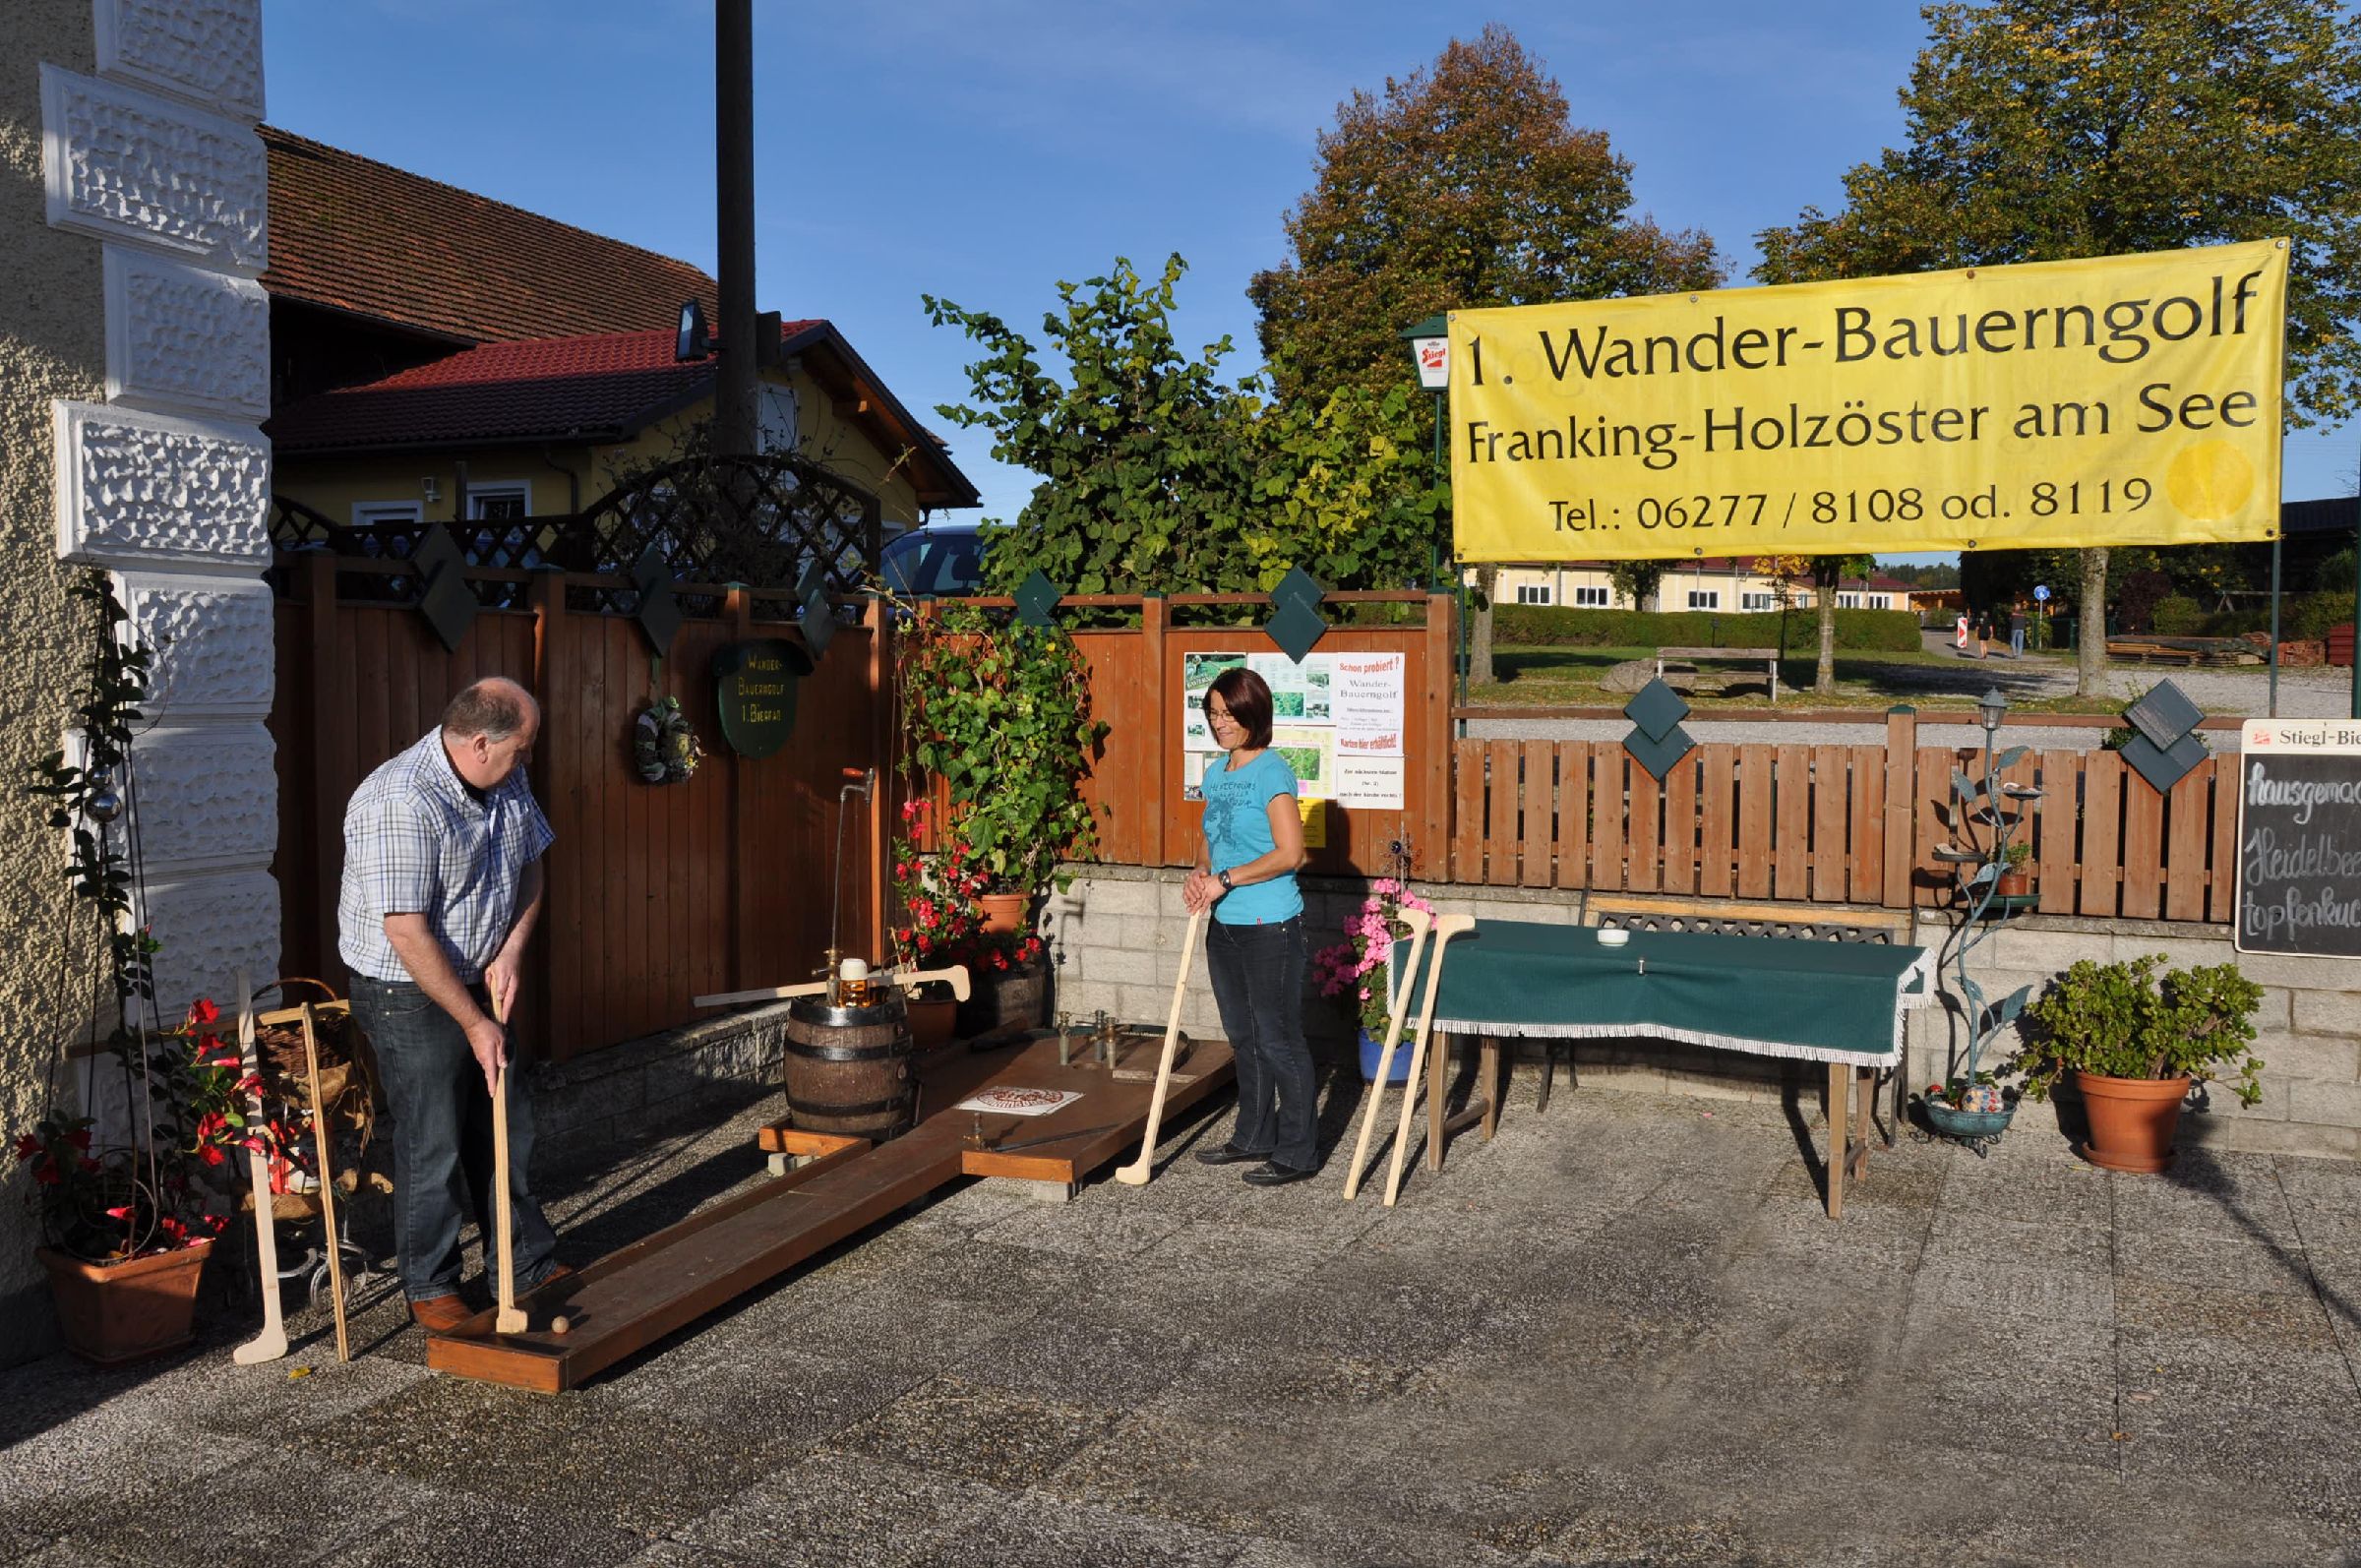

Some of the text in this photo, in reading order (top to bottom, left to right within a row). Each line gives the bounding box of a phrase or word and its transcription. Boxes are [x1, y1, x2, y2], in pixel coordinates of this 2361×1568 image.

[1468, 271, 2263, 387] 1. Wander-Bauerngolf
[1468, 383, 2258, 470] Franking-Holzöster am See
[1548, 476, 2152, 532] Tel.: 06277 / 8108 od. 8119
[1339, 662, 1362, 674] Schon
[1363, 658, 1394, 675] probiert
[1349, 679, 1392, 688] Wander-
[1340, 690, 1398, 700] Bauerngolf
